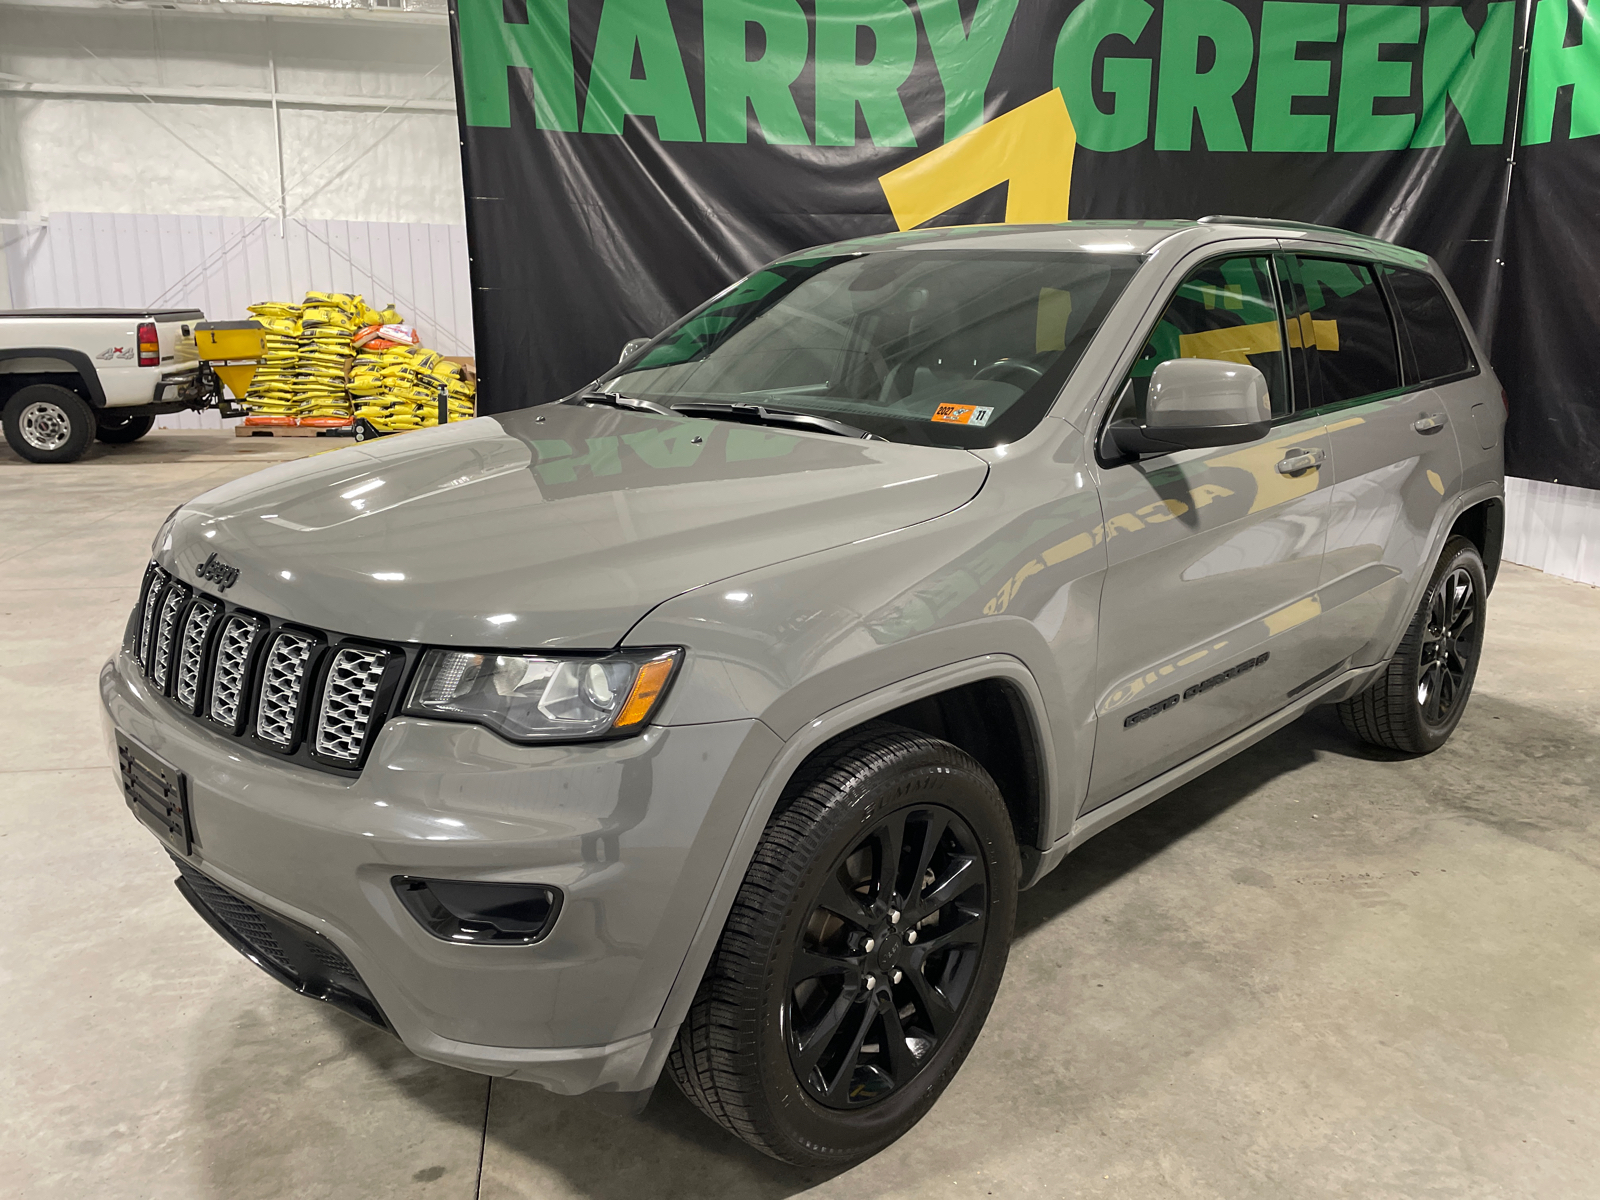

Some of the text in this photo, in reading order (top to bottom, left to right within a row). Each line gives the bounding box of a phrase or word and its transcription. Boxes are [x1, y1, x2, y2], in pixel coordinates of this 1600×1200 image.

[459, 0, 1515, 153] HARRY GREEN
[936, 406, 955, 416] 2027
[975, 410, 987, 421] 11
[195, 552, 240, 593] Jeep
[1123, 693, 1181, 730] GRAND
